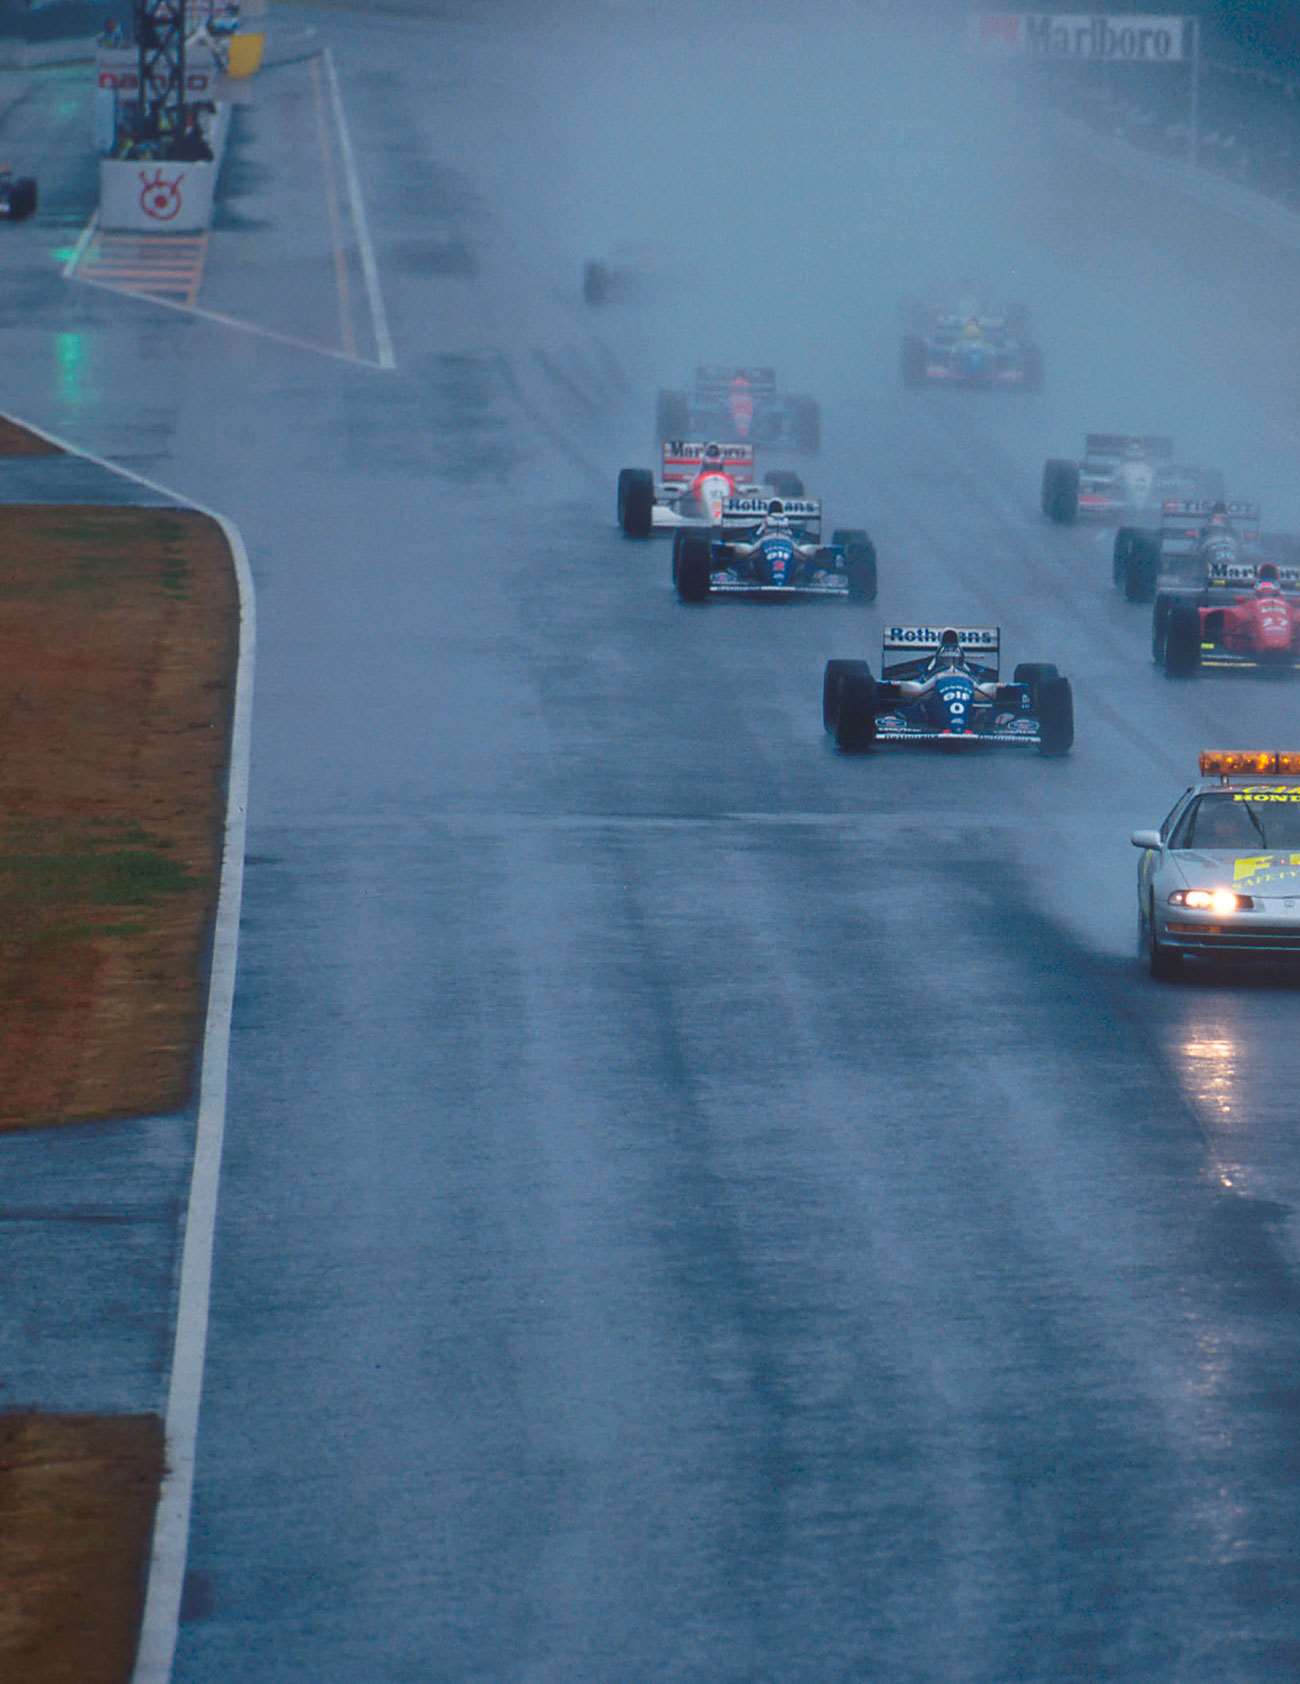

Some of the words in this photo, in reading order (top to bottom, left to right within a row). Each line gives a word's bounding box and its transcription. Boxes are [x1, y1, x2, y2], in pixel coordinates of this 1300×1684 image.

[1025, 15, 1171, 53] Marlboro
[728, 499, 816, 513] Rothans
[890, 627, 992, 643] Rothans
[949, 702, 965, 714] 0
